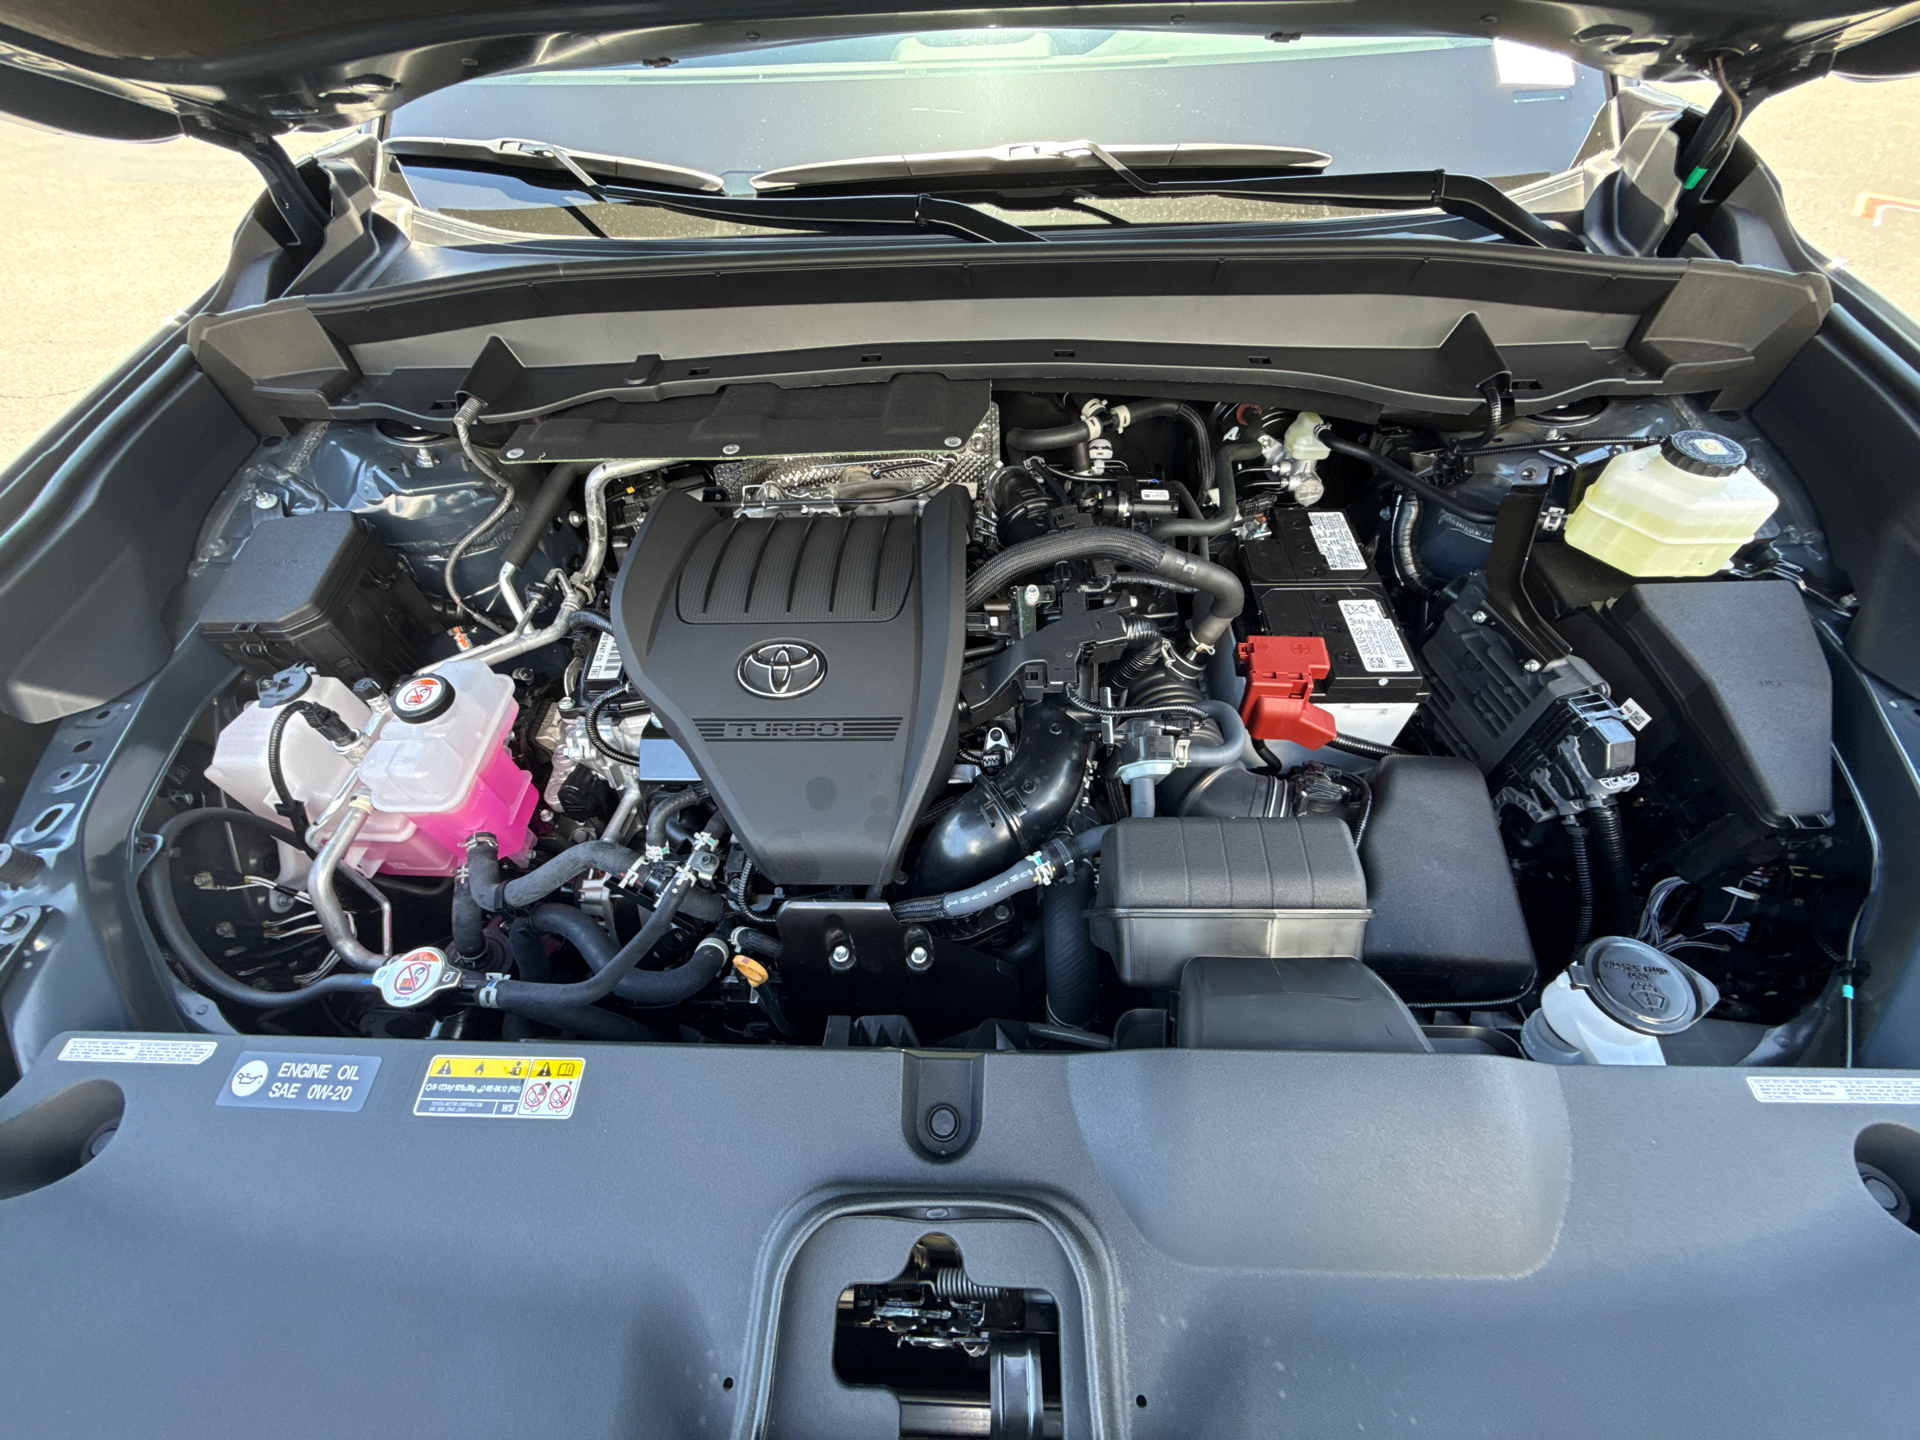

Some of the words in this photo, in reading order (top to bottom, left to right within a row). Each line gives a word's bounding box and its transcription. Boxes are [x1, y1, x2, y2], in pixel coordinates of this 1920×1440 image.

[728, 722, 840, 737] TURBO
[277, 1062, 332, 1079] ENGINE
[337, 1065, 360, 1081] OIL
[268, 1082, 302, 1099] SAE
[306, 1084, 353, 1101] 0W-20
[501, 1104, 514, 1112] WS
